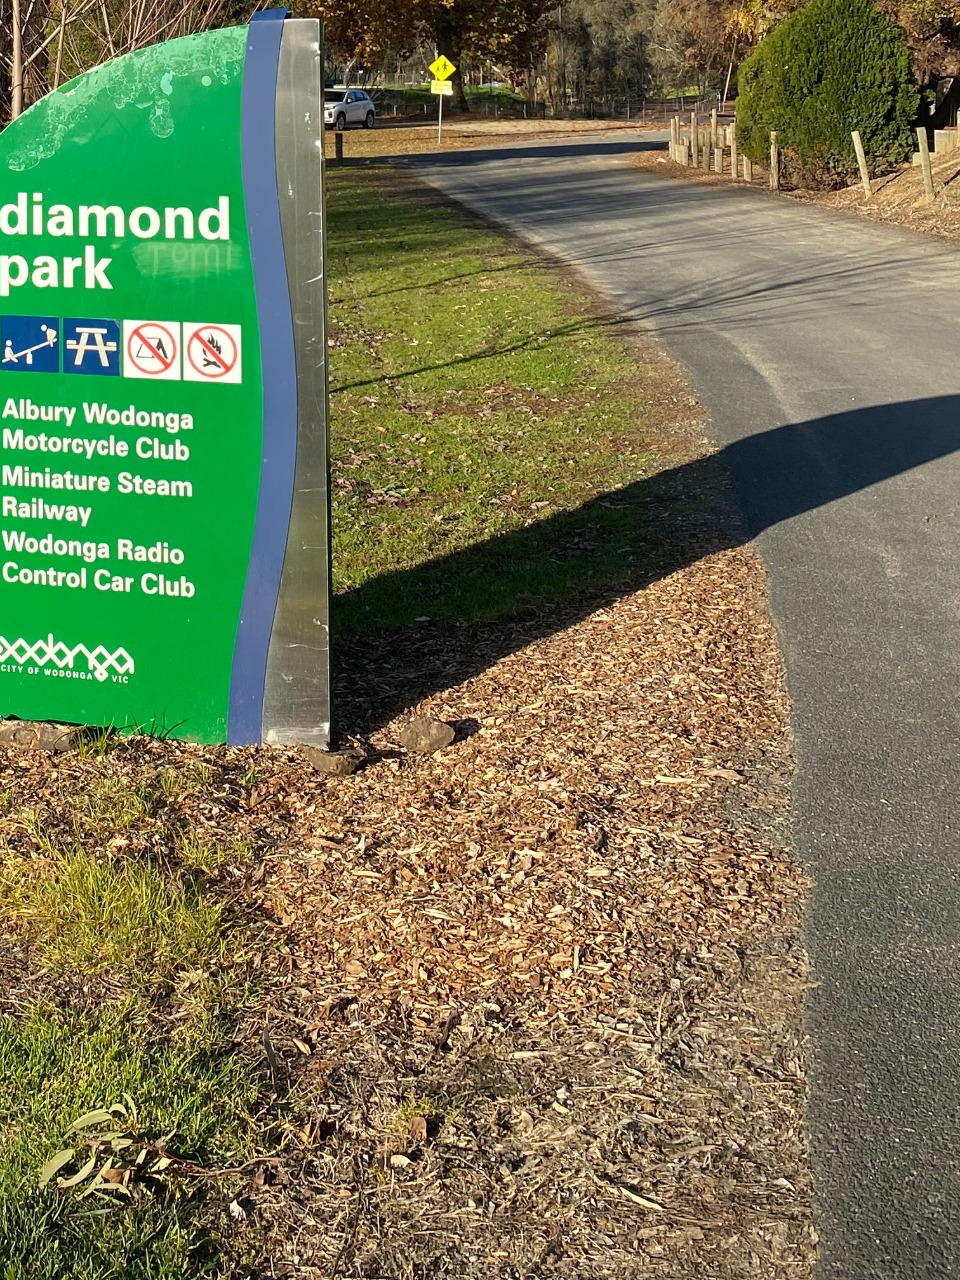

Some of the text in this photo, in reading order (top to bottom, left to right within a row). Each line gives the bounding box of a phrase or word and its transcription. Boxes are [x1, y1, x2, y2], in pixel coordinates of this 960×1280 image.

[0, 245, 113, 297] park
[1, 398, 194, 433] Albury Wodonga
[2, 428, 190, 461] Motorcycle Club
[2, 465, 193, 497] Miniature Steam
[2, 495, 92, 527] Railway
[1, 530, 185, 565] Wodonga Radio
[2, 561, 195, 598] Control Car Club
[0, 664, 129, 684] CITY OF WODONGA VIC
